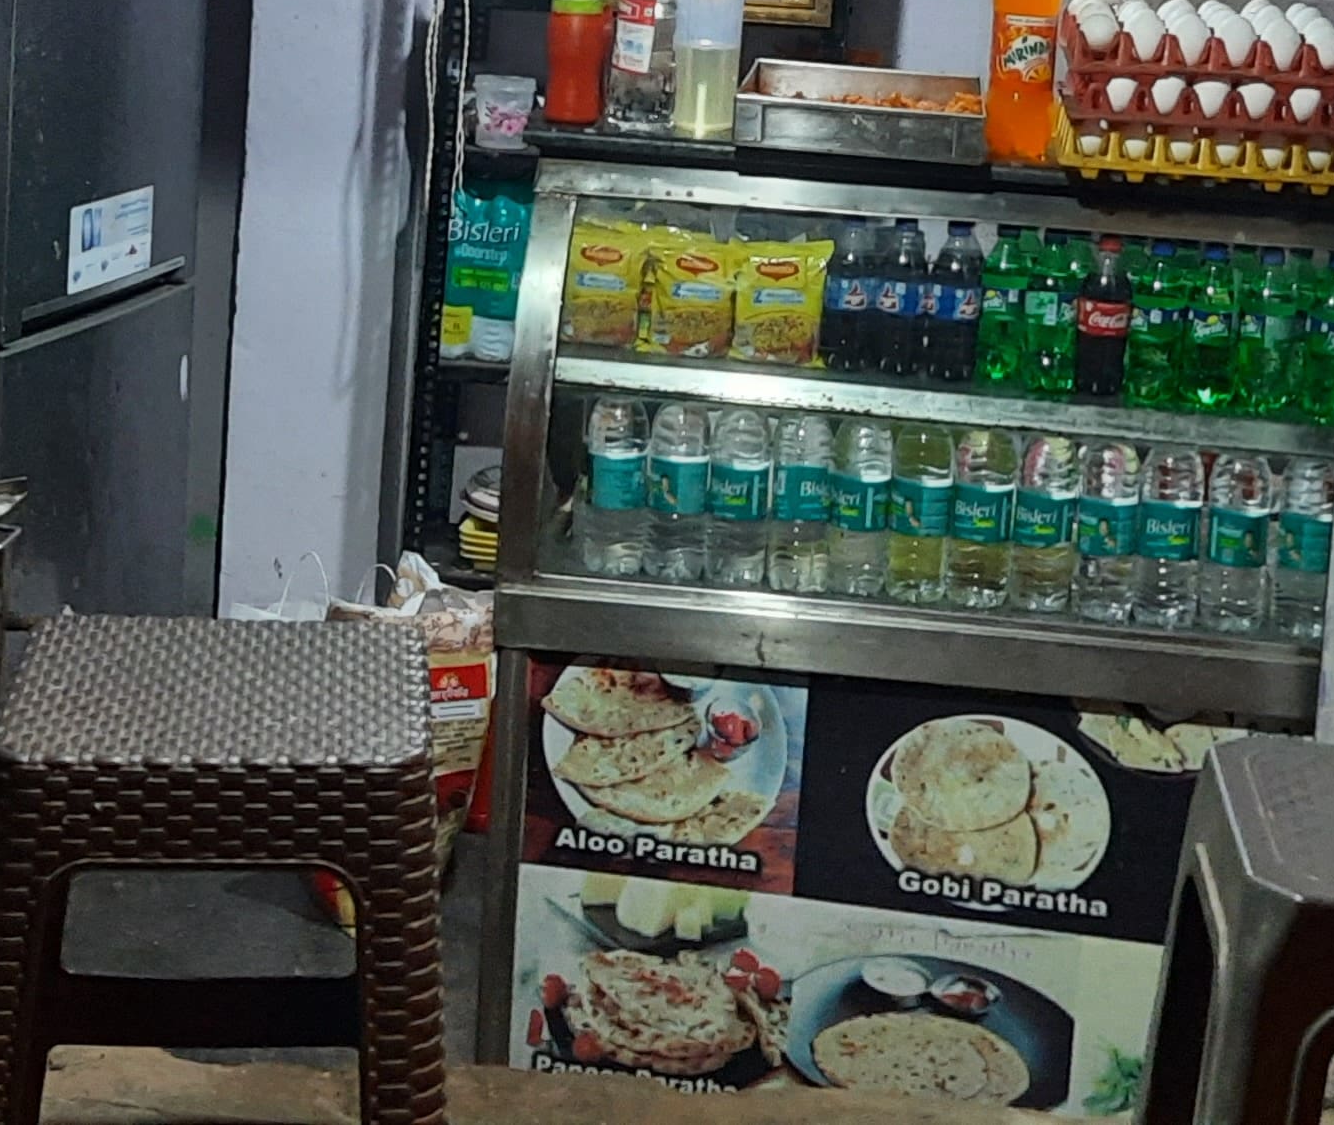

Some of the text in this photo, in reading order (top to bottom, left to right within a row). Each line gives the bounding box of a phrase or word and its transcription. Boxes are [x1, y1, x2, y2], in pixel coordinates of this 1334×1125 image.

[447, 218, 520, 243] Bisleri
[710, 480, 749, 496] isleri
[555, 827, 758, 872] Aloo Paratha
[898, 870, 1109, 917] Gobi Paratha
